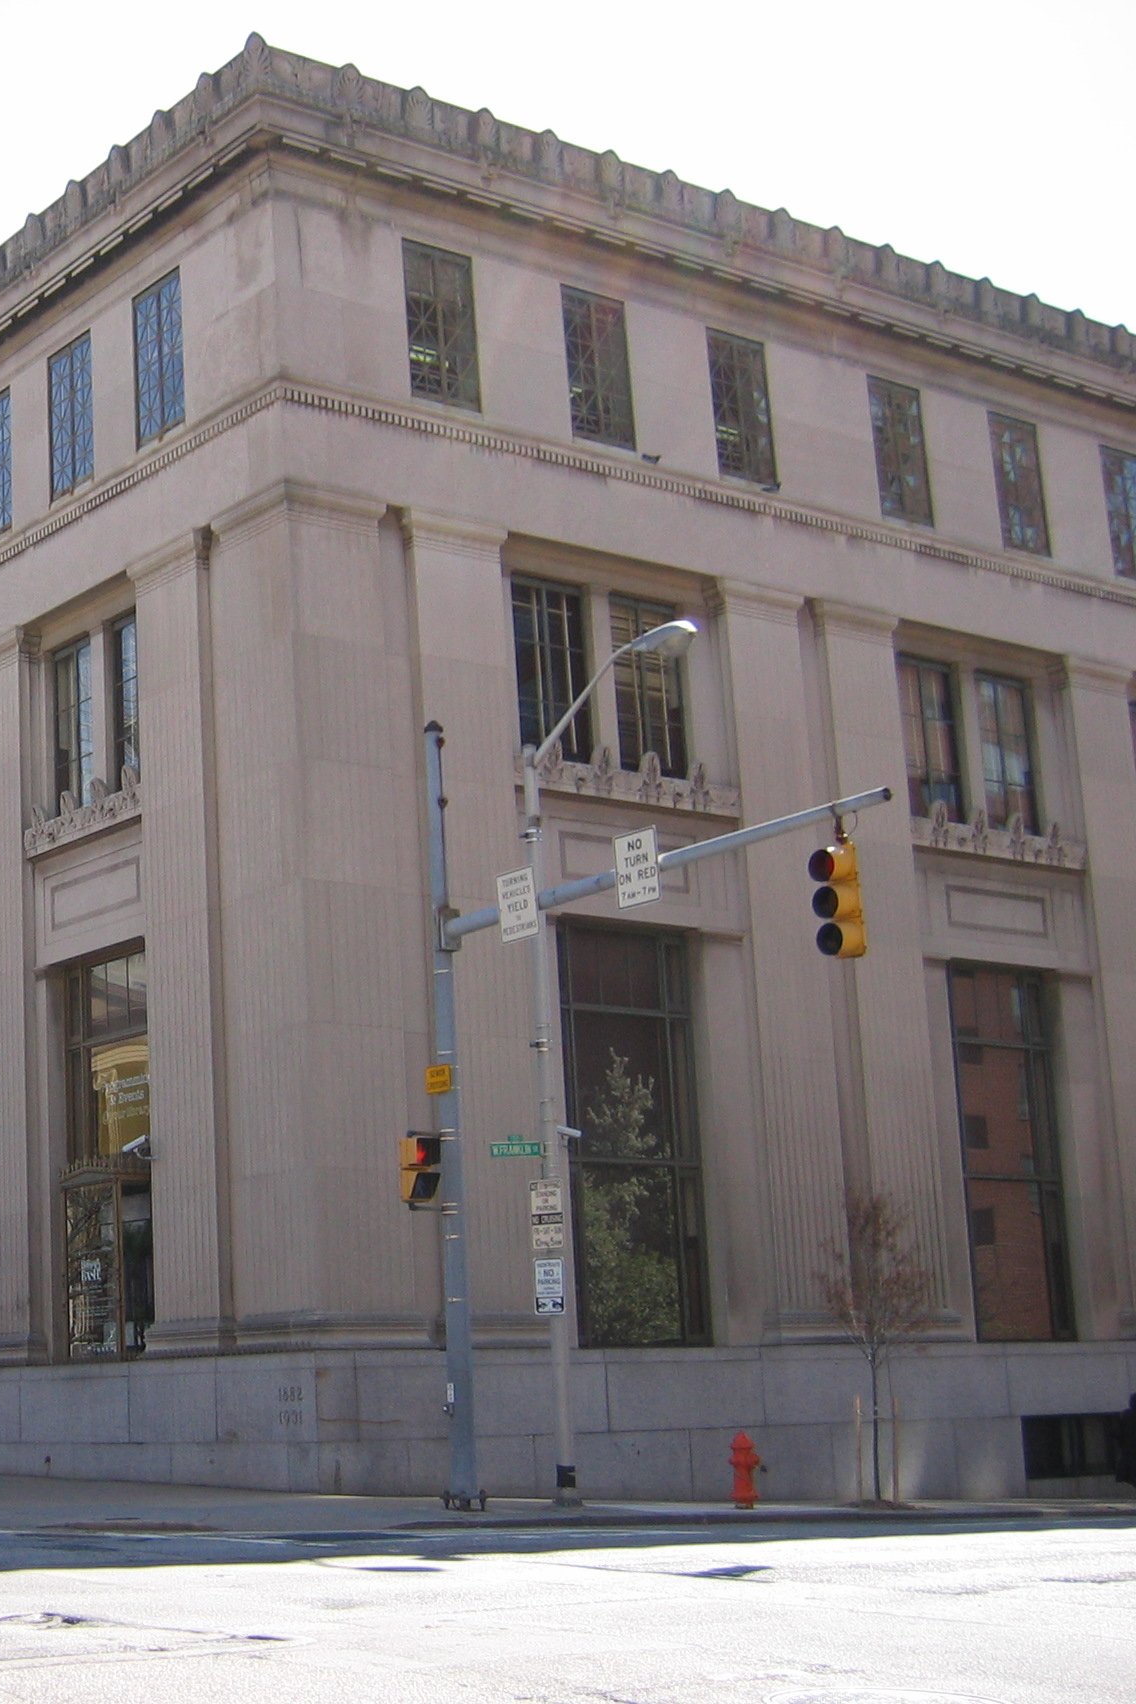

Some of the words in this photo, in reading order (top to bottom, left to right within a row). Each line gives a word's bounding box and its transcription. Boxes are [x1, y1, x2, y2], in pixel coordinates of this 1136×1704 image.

[627, 838, 642, 852] NO
[624, 851, 649, 868] TURN
[619, 872, 632, 886] ON
[637, 866, 656, 881] RED
[506, 899, 529, 913] YIELD
[543, 1268, 555, 1277] NO
